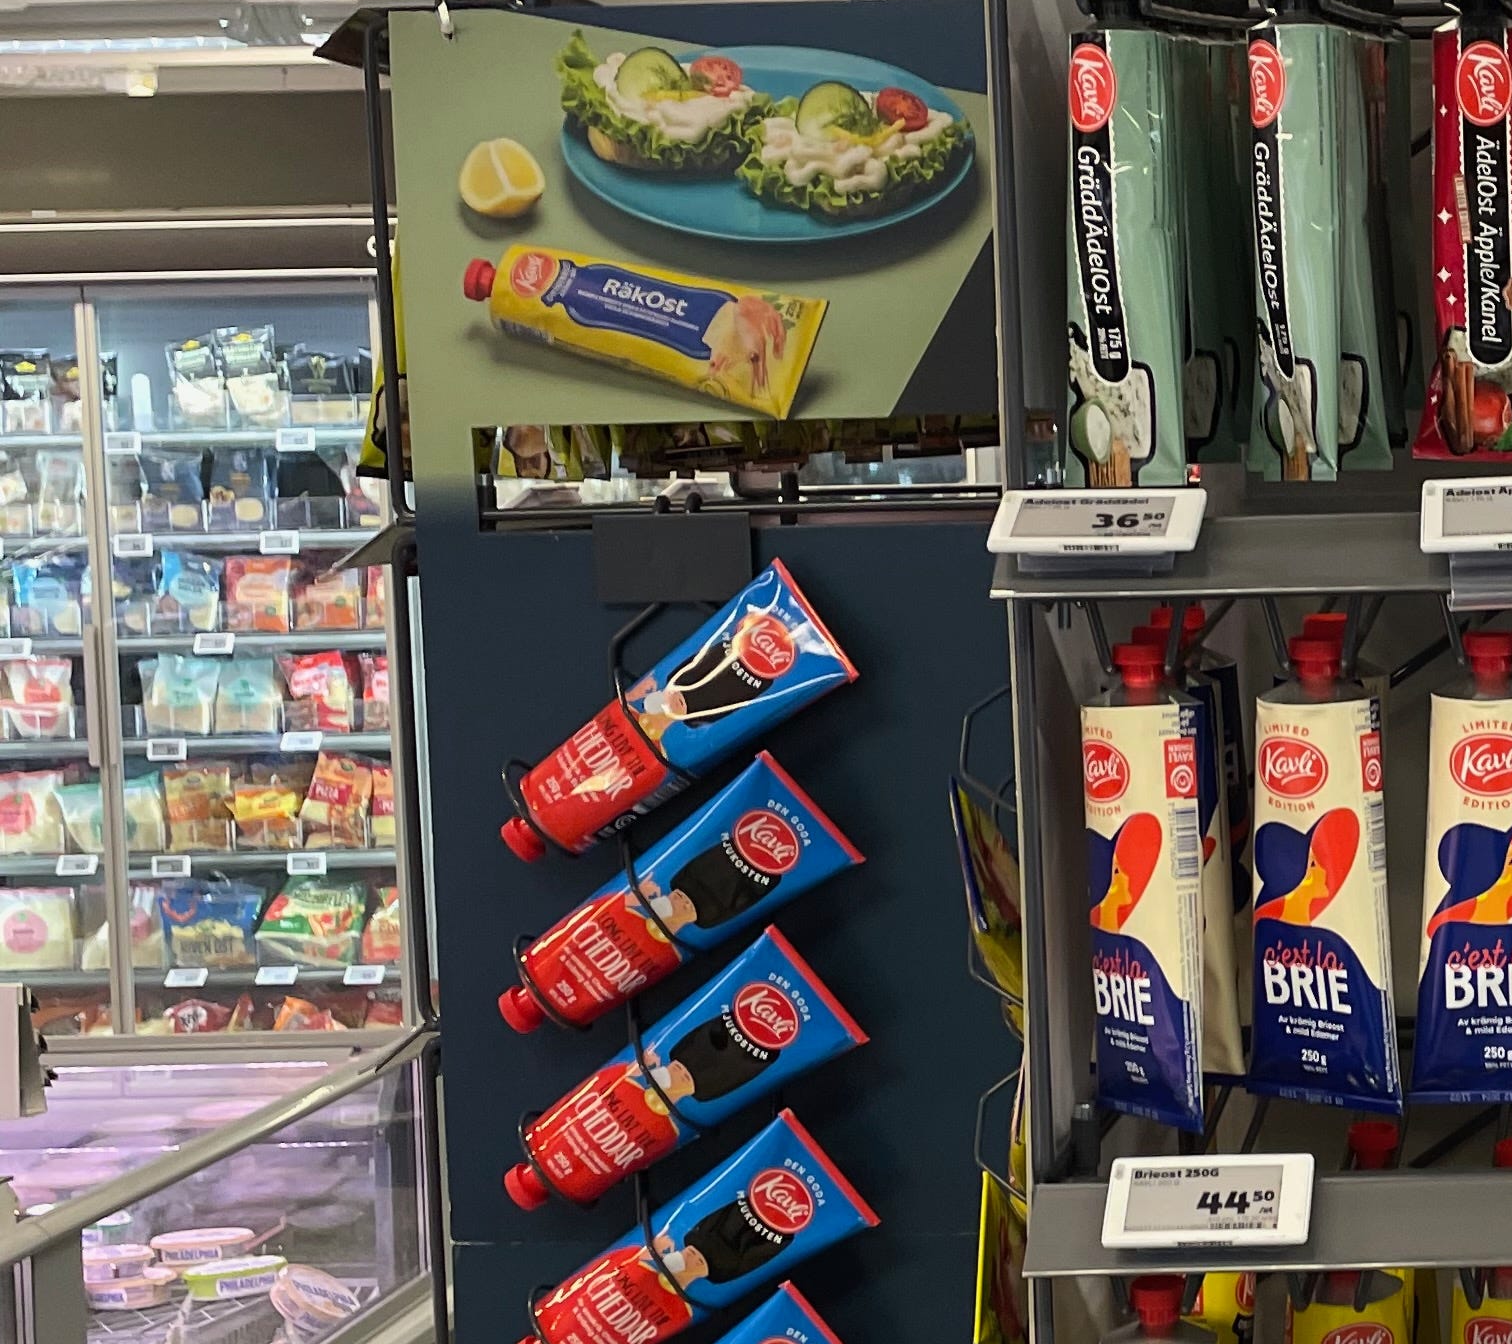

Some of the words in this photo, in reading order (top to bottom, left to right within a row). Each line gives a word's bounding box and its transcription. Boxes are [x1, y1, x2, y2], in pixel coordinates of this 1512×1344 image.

[1475, 134, 1501, 216] ÄdelOst
[1077, 145, 1112, 314] GräddÄdelOst
[1254, 142, 1280, 310] GräddÄdelOst
[603, 278, 689, 317] RäkOst
[1473, 220, 1503, 344] Äpple/Kanel
[1091, 513, 1140, 529] 36
[748, 619, 791, 672] Kavli
[1264, 723, 1310, 737] LIMITED
[1263, 746, 1319, 785] Kavli
[767, 798, 789, 818] DEN
[791, 816, 812, 848] GODA
[1266, 798, 1317, 812] EDITION
[720, 831, 771, 887] MJUKOSTEN
[743, 816, 798, 867] Kavli
[571, 918, 648, 995] CHEDDAR
[1447, 937, 1508, 971] c'est
[768, 971, 788, 992] DEN
[790, 990, 812, 1024] GODA
[1093, 971, 1155, 1025] BRIE
[1263, 958, 1352, 1015] BRIE
[720, 1003, 769, 1061] MJUKOSTEN
[1301, 1048, 1320, 1063] 250
[1483, 1045, 1506, 1060] 250
[573, 1090, 645, 1170] CHEDDAR
[783, 1158, 805, 1176] DEN
[1134, 1167, 1182, 1179] Brieost
[1184, 1167, 1220, 1179] 250G
[735, 1189, 784, 1245] MJUKOSTEN
[1196, 1191, 1250, 1215] 44
[1252, 1190, 1275, 1202] 50
[218, 1275, 277, 1293] PHILADELPHIA
[785, 1325, 808, 1344] DEN
